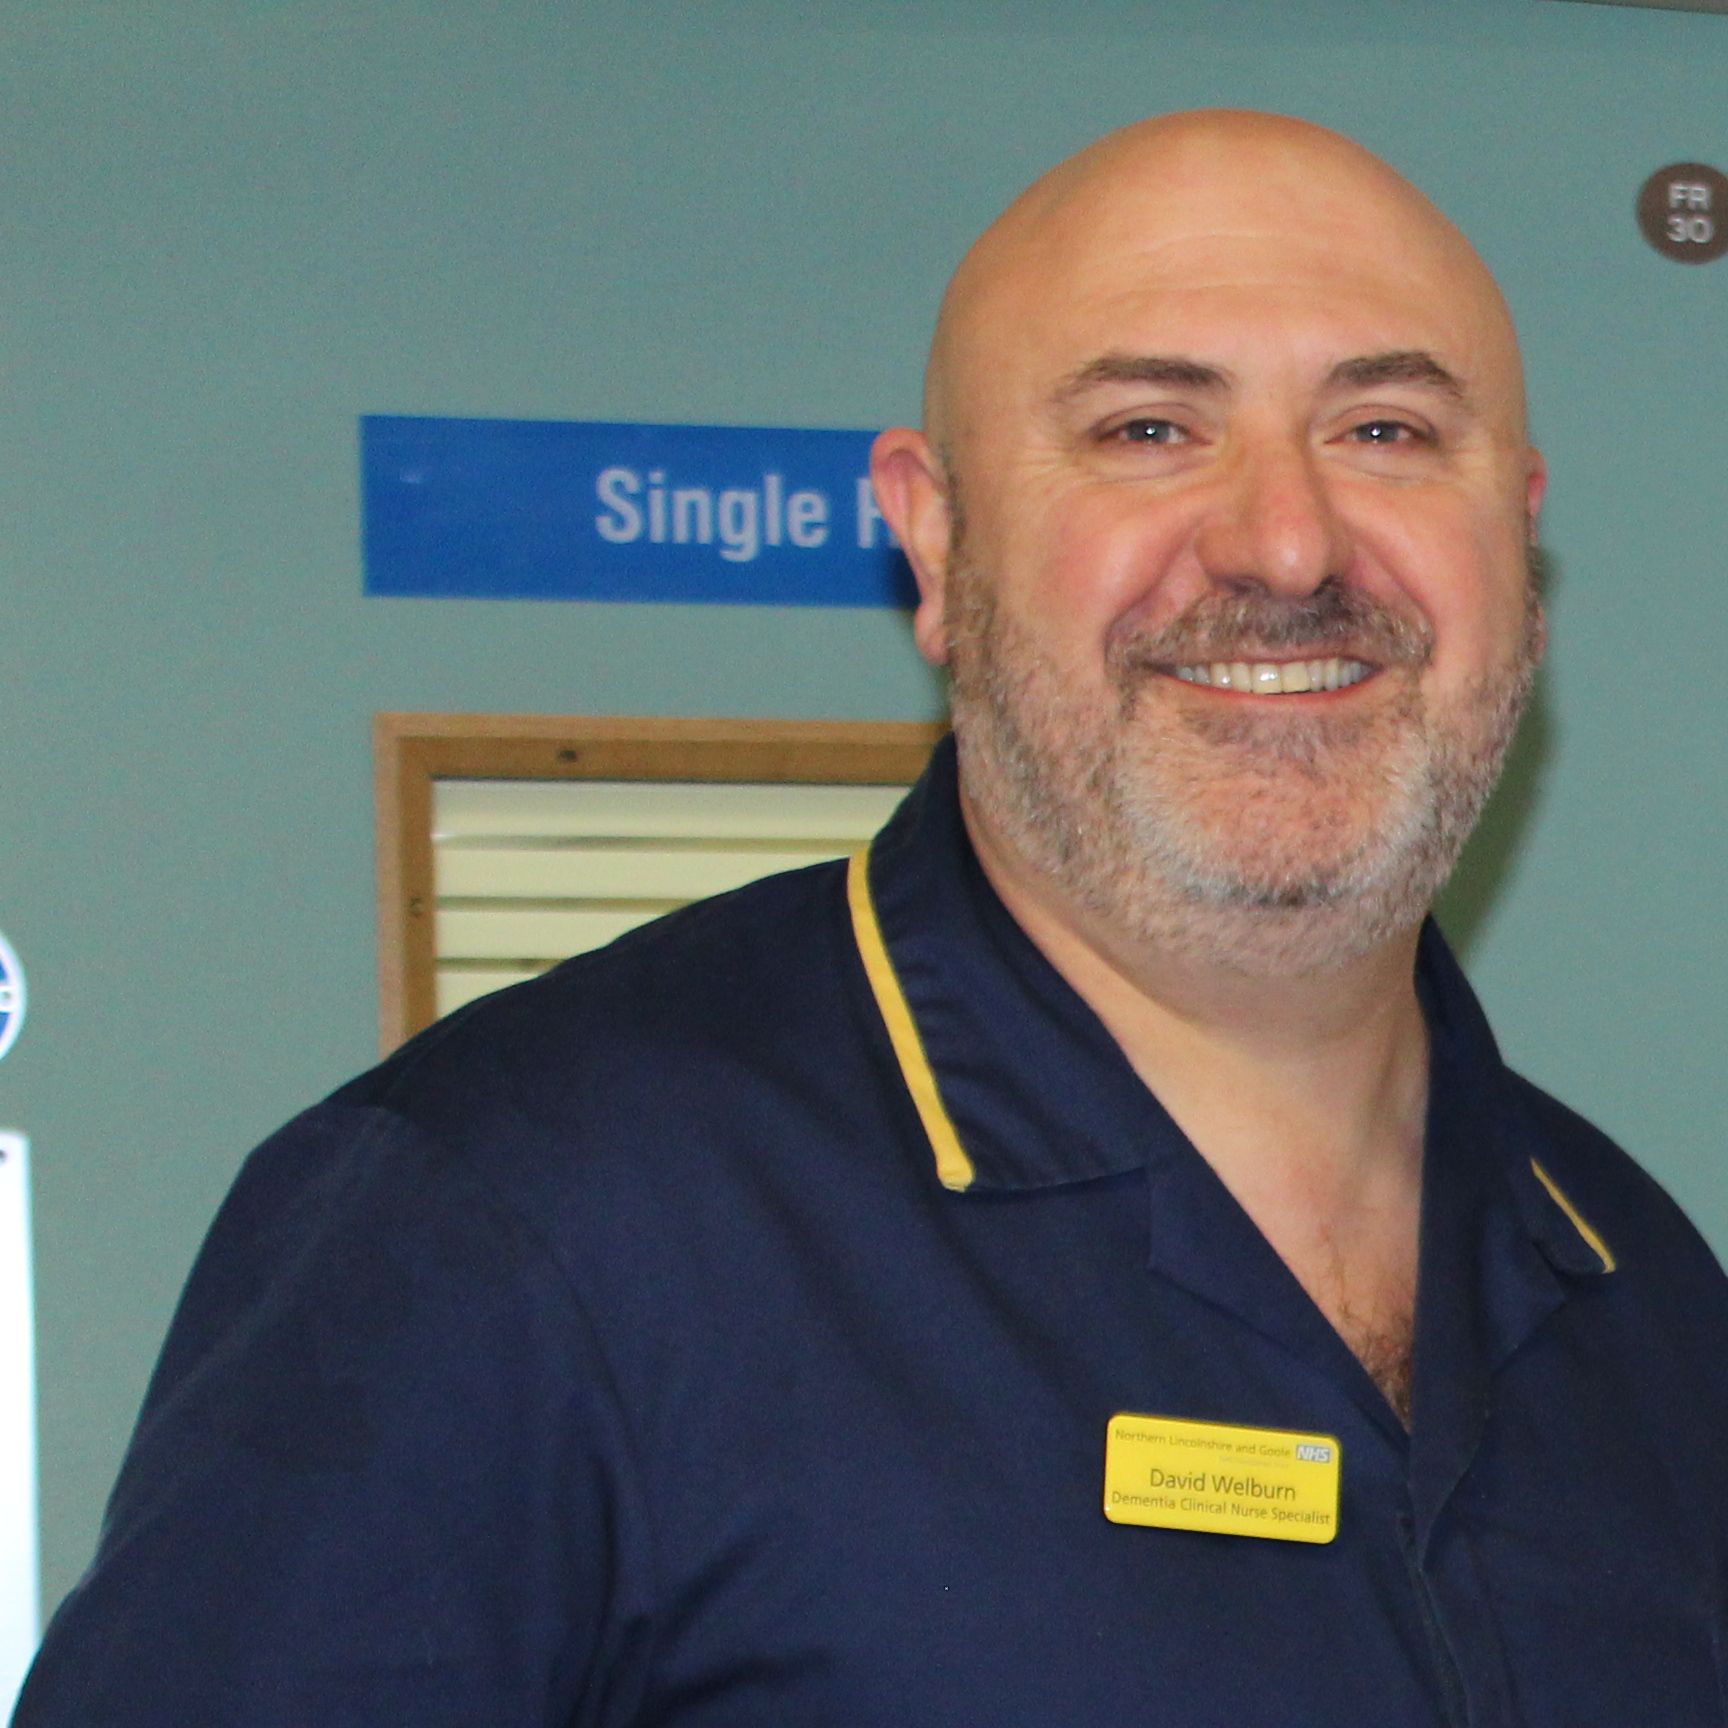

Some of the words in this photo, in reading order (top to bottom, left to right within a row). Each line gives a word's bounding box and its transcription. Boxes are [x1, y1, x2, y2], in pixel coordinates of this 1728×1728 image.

[1668, 181, 1711, 210] FR
[1666, 213, 1713, 244] 30
[594, 465, 830, 563] Single
[1115, 1428, 1166, 1445] Northern
[1168, 1435, 1232, 1451] Lincolnshire
[1236, 1441, 1257, 1455] and
[1259, 1444, 1291, 1458] Goole
[1297, 1445, 1331, 1462] NHS
[1150, 1468, 1206, 1492] David
[1211, 1475, 1297, 1501] Welburn
[1111, 1491, 1176, 1511] Dementia
[1180, 1497, 1227, 1515] Clinical
[1230, 1503, 1268, 1519] Nurse
[1271, 1508, 1331, 1526] Specialist
